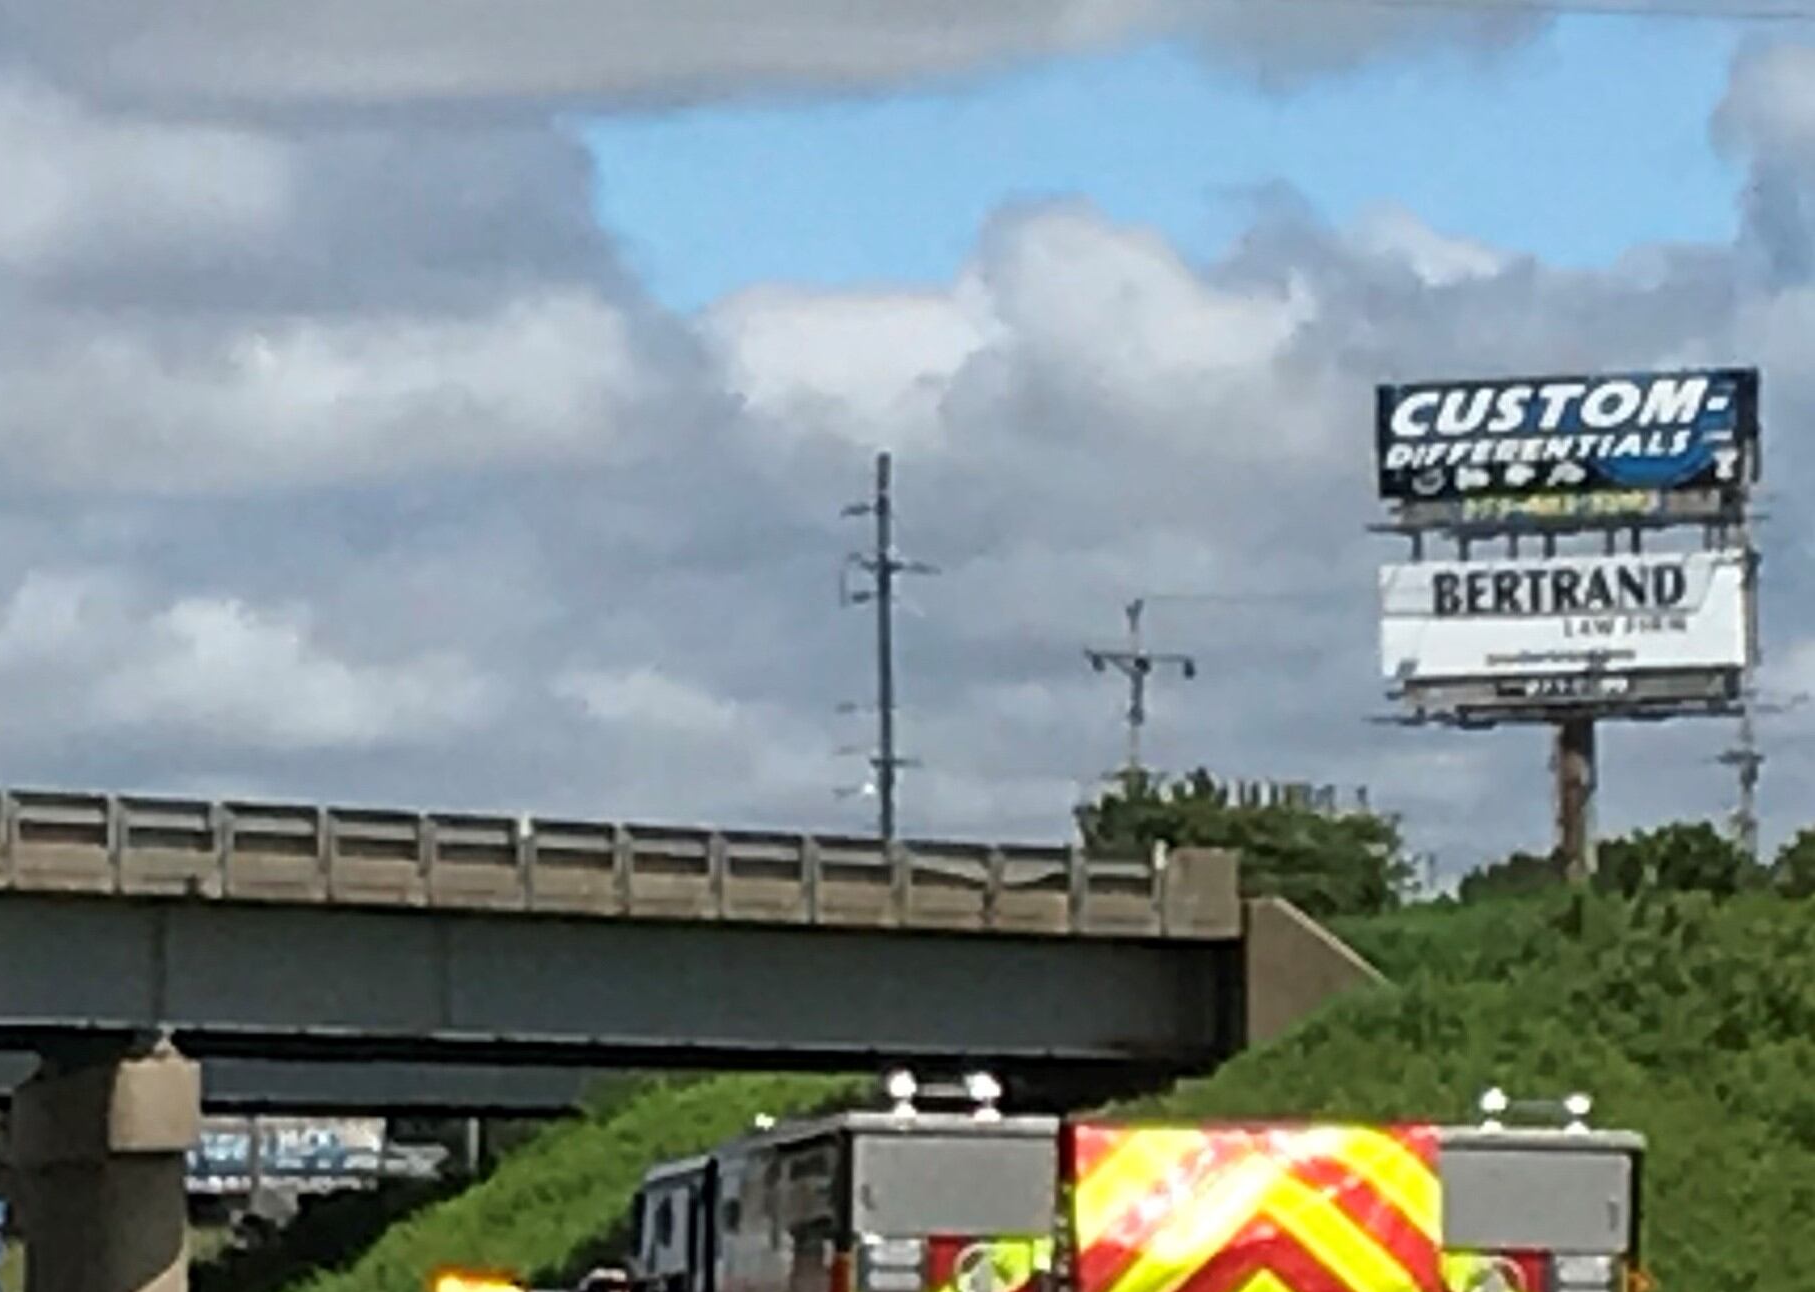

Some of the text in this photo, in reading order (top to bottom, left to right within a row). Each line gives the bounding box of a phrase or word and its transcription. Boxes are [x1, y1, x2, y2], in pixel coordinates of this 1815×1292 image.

[1385, 430, 1691, 470] DIFFERENTIALS
[1432, 563, 1687, 617] BERTRAND
[1563, 617, 1615, 638] LAW
